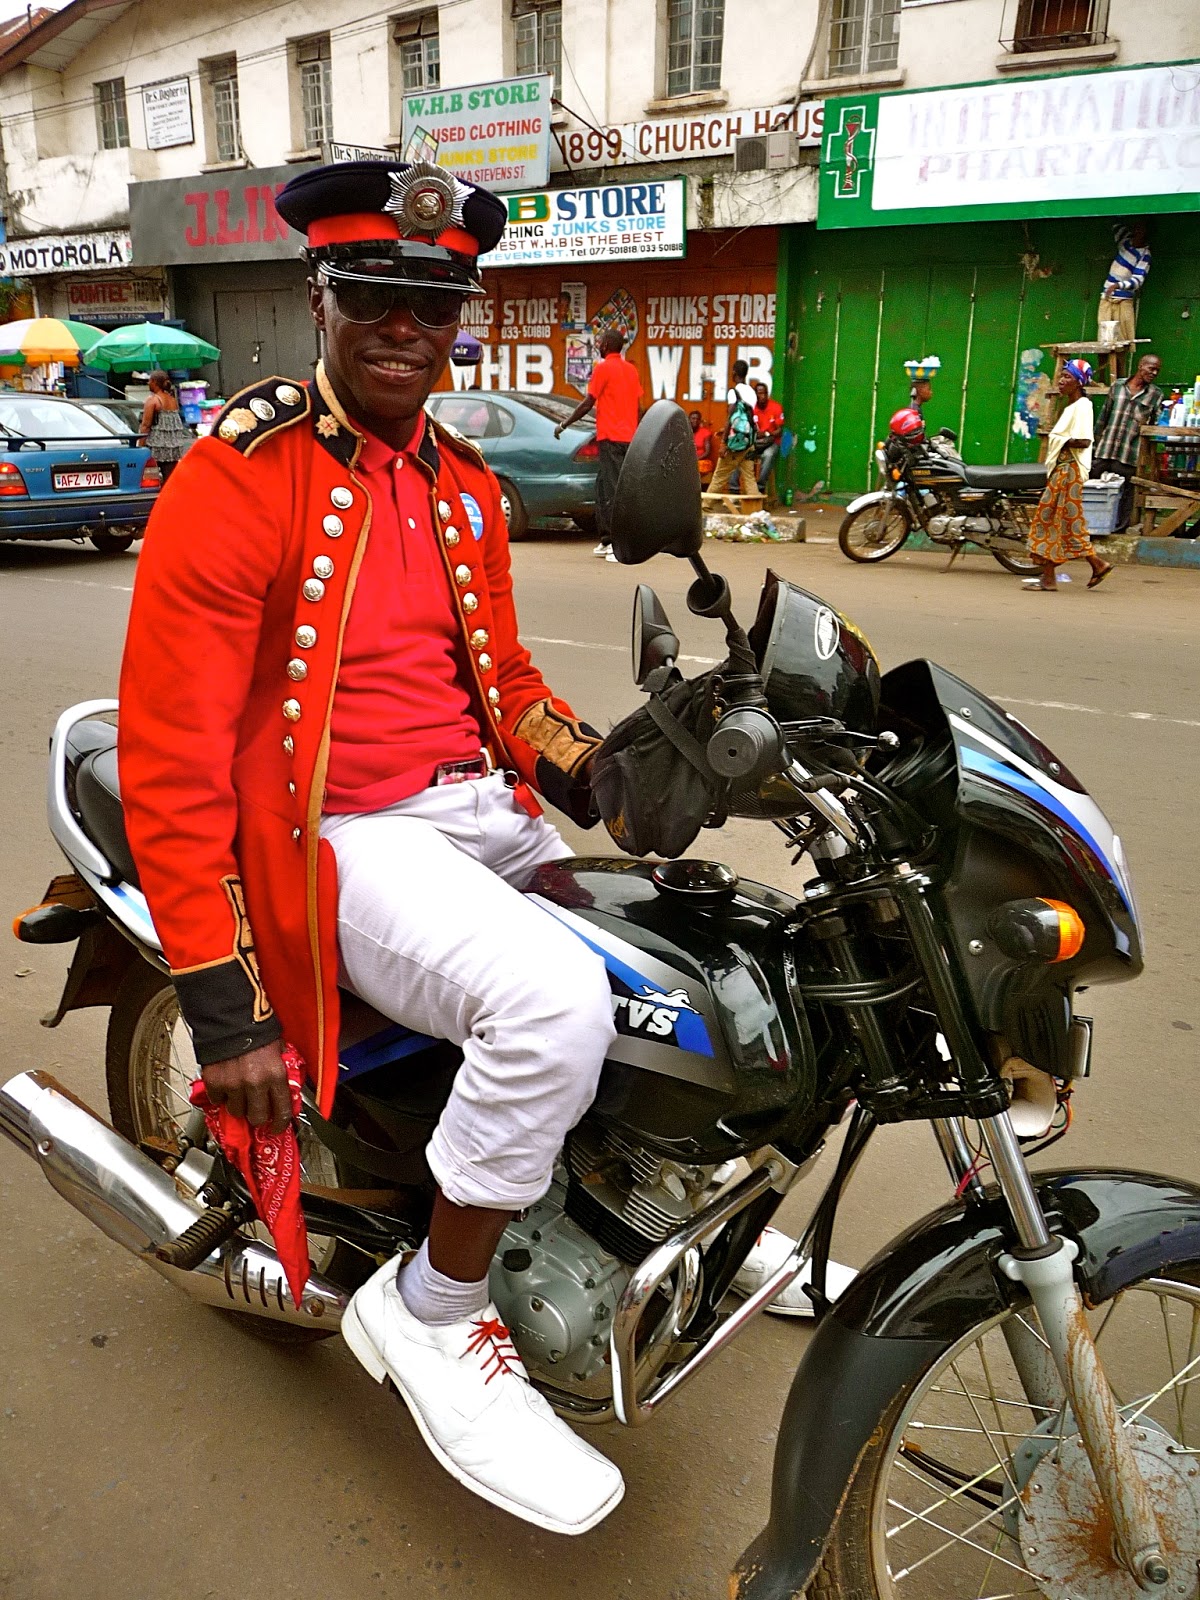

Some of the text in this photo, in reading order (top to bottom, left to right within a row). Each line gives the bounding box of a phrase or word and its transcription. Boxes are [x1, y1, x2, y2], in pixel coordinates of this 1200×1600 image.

[407, 82, 540, 118] W.H.B STORE
[431, 117, 542, 143] USED CLOTHING
[639, 116, 742, 157] CHURCH
[437, 144, 538, 167] JUNKS STORE
[474, 166, 512, 182] STEVENS
[556, 183, 666, 221] STORE
[551, 220, 611, 237] JUNKS
[616, 216, 666, 232] STORE
[570, 236, 584, 248] IS
[587, 234, 618, 246] THE
[621, 231, 664, 244] BEST
[9, 241, 123, 270] MOTOROLA
[477, 250, 542, 263] STEVENS
[503, 298, 558, 325] STORE
[646, 294, 776, 326] JUNKS STORE
[61, 474, 80, 487] AFZ
[85, 473, 104, 486] 970
